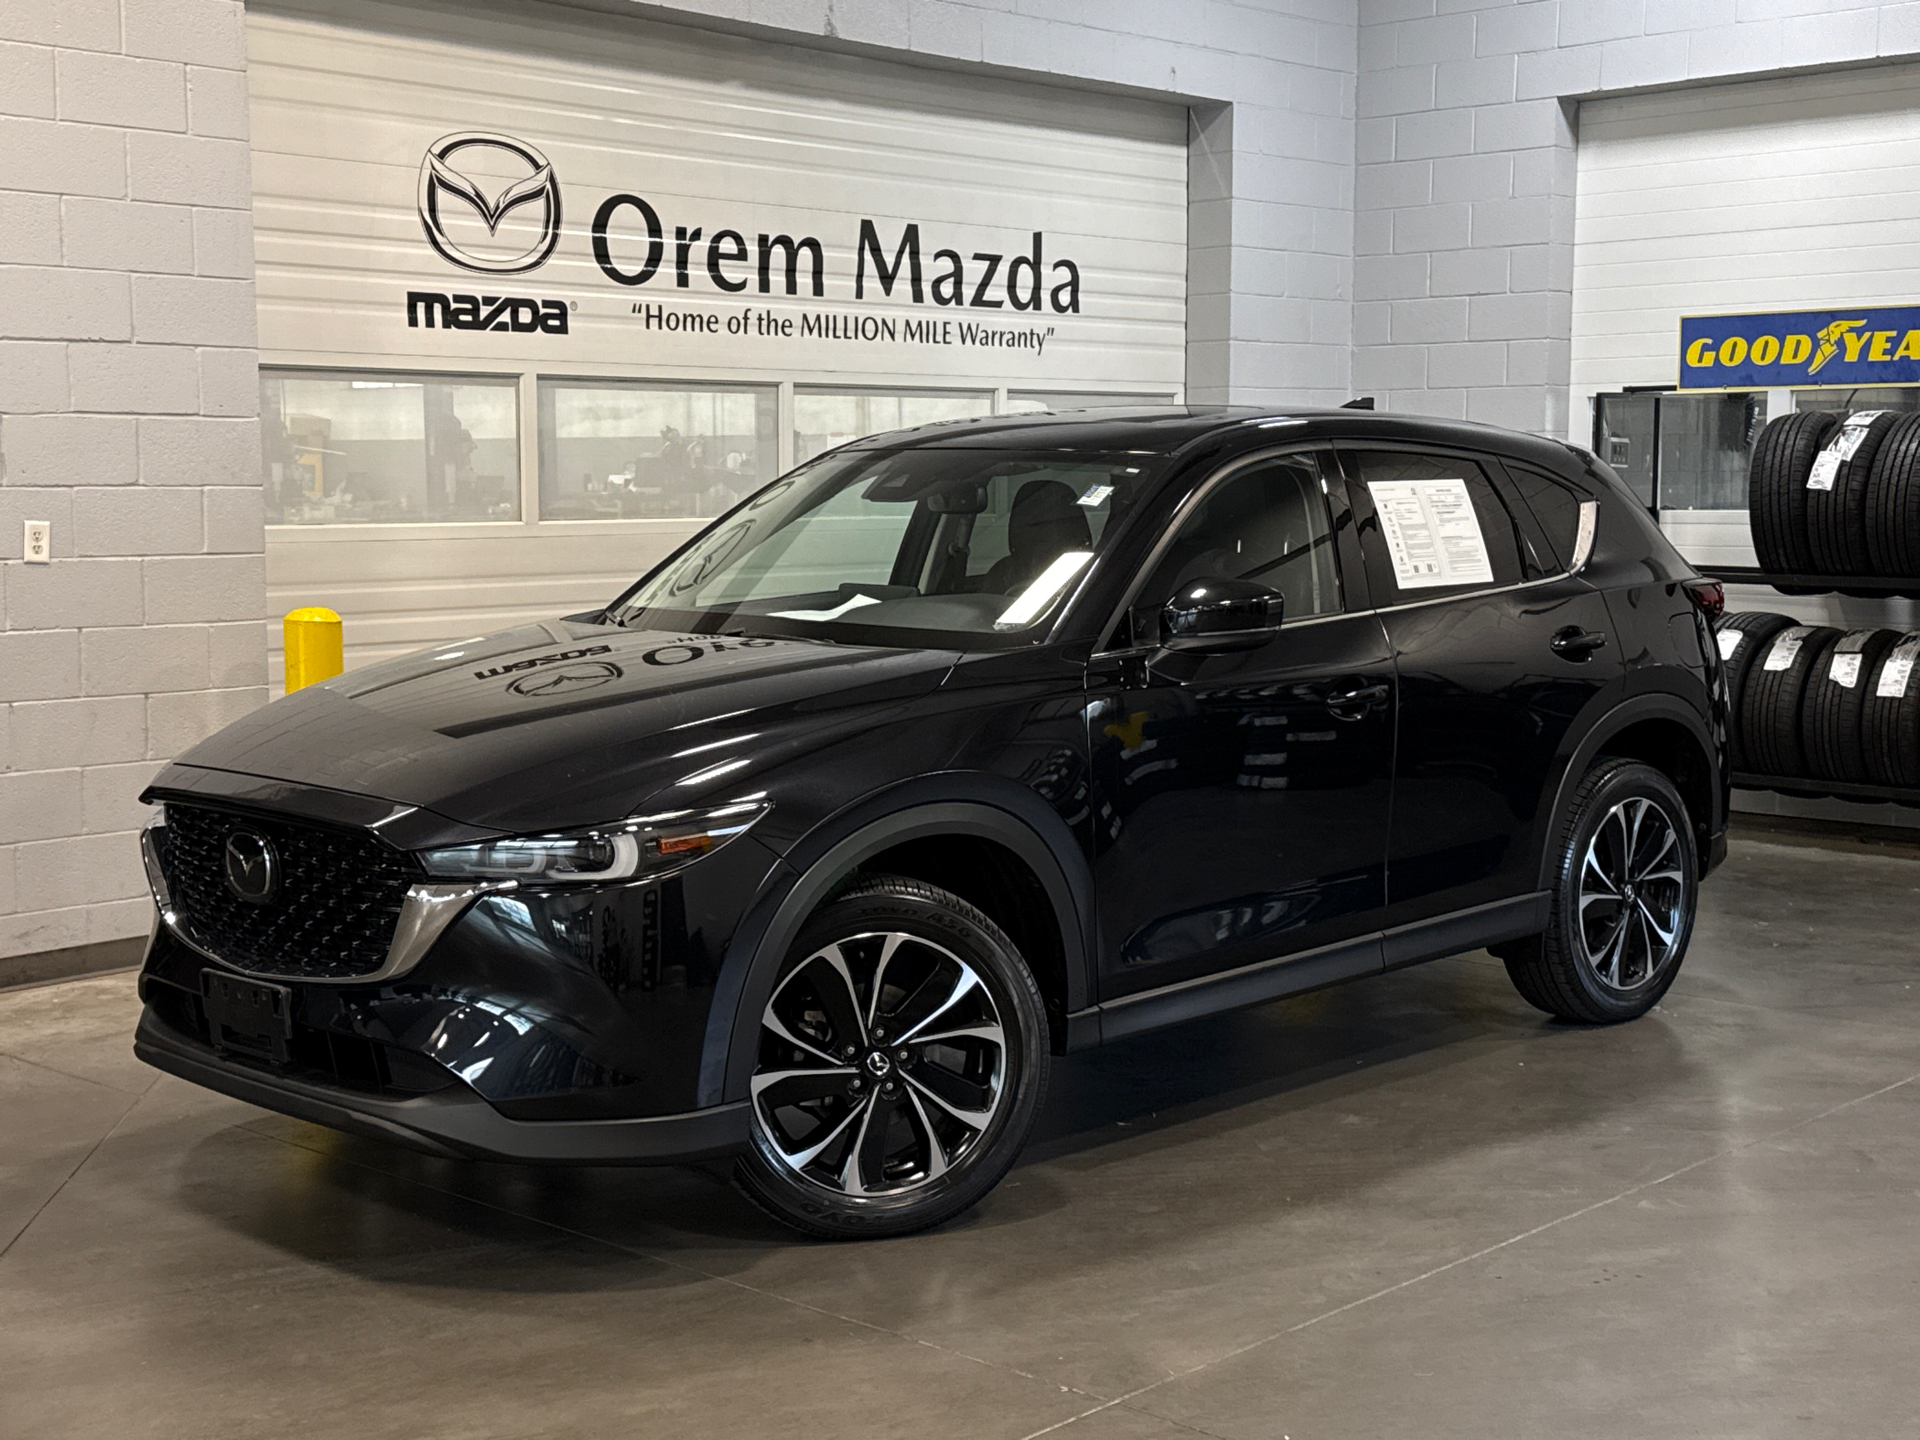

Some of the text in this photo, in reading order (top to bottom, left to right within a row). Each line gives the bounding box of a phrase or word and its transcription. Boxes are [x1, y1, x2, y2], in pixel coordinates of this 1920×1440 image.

[592, 193, 1080, 314] Orem Mazda
[727, 308, 752, 335] of
[757, 310, 793, 337] the
[800, 313, 896, 342] MILLION
[903, 319, 953, 345] MILE
